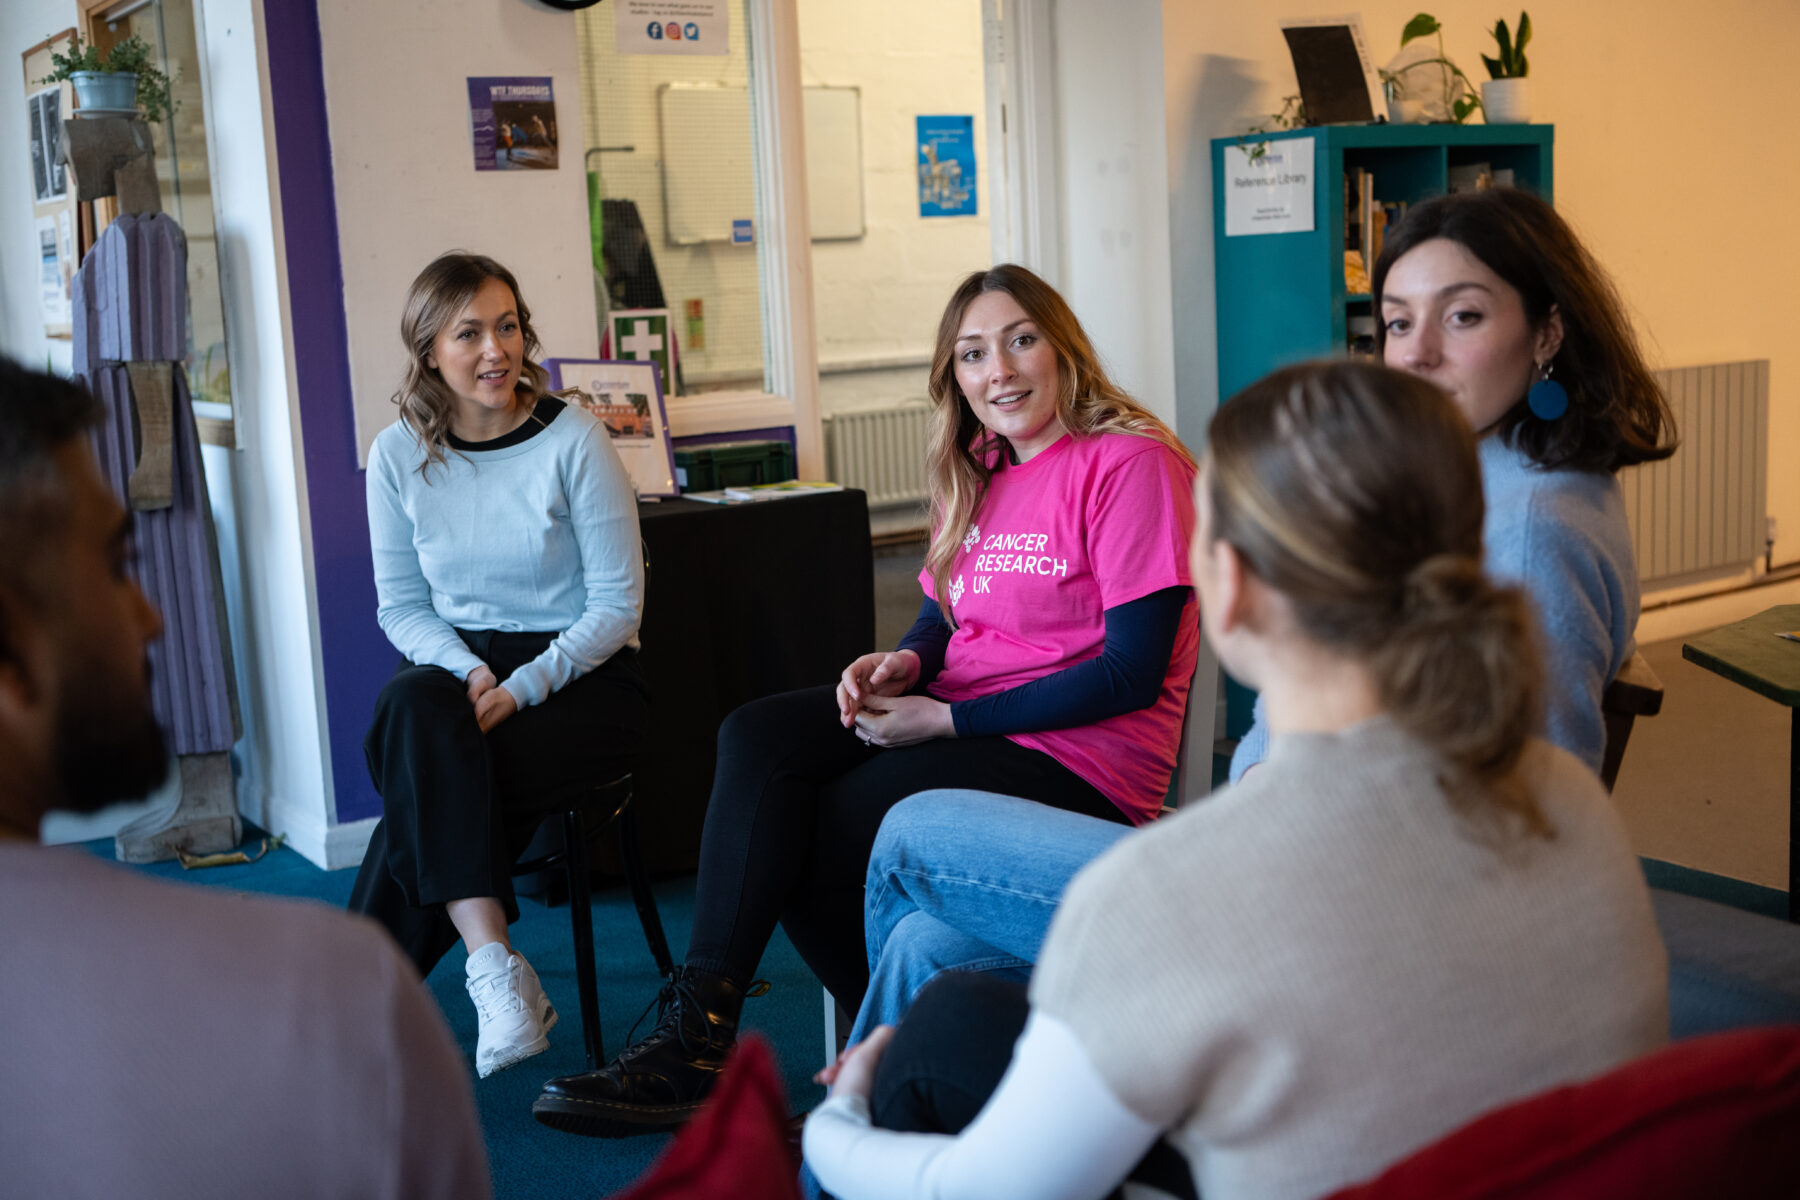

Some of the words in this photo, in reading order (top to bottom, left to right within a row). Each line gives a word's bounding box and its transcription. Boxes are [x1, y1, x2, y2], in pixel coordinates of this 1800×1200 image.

[489, 86, 506, 96] WTF
[508, 86, 551, 96] THURSDAYS
[1234, 176, 1276, 188] Reference
[1278, 174, 1307, 186] Library
[983, 533, 1048, 552] CANCER
[974, 554, 1067, 577] RESEARCH
[973, 575, 993, 594] UK
